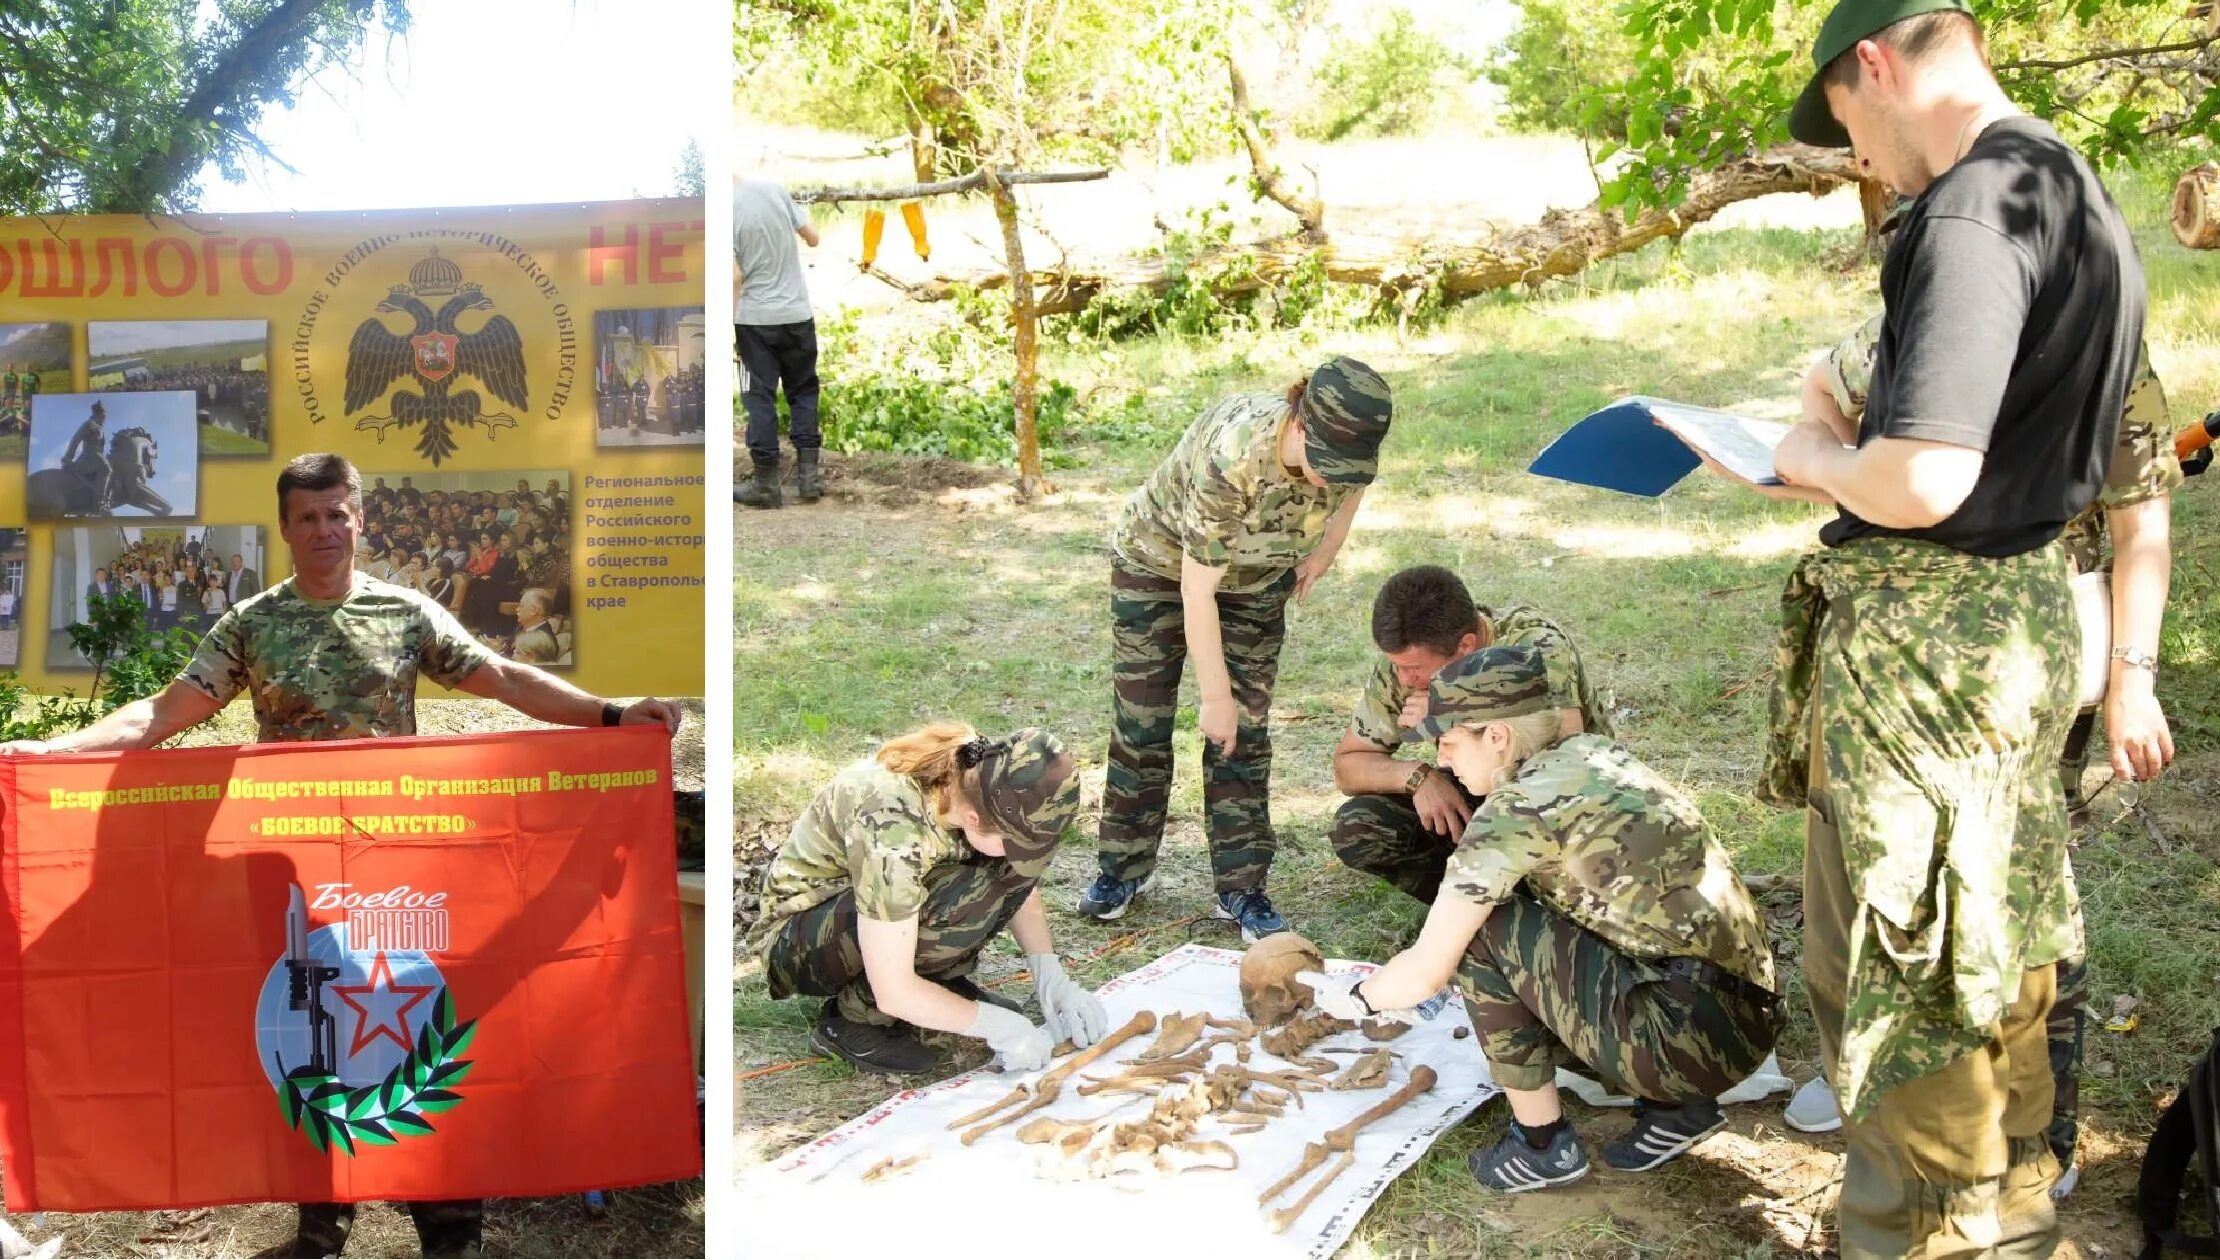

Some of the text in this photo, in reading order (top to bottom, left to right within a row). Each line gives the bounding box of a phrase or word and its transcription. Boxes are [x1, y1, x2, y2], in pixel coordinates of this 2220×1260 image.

[0, 236, 294, 298] ШЛОГО
[293, 290, 329, 427] РОССИЙСКОЕ
[545, 302, 576, 421] ОБЩЕСТВО
[585, 475, 705, 489] Региональное
[585, 496, 675, 510] отделение
[586, 513, 691, 527] Российского
[587, 533, 705, 549] военно-истор
[587, 554, 668, 569] общества
[587, 577, 596, 587] в
[586, 597, 627, 611] крае
[49, 769, 658, 812] Всероссийская Общественная Организация Ветеранов
[250, 816, 345, 836] «БОЕВОЕ
[311, 882, 448, 910] Боевое
[348, 908, 449, 951] БРАТСТВО
